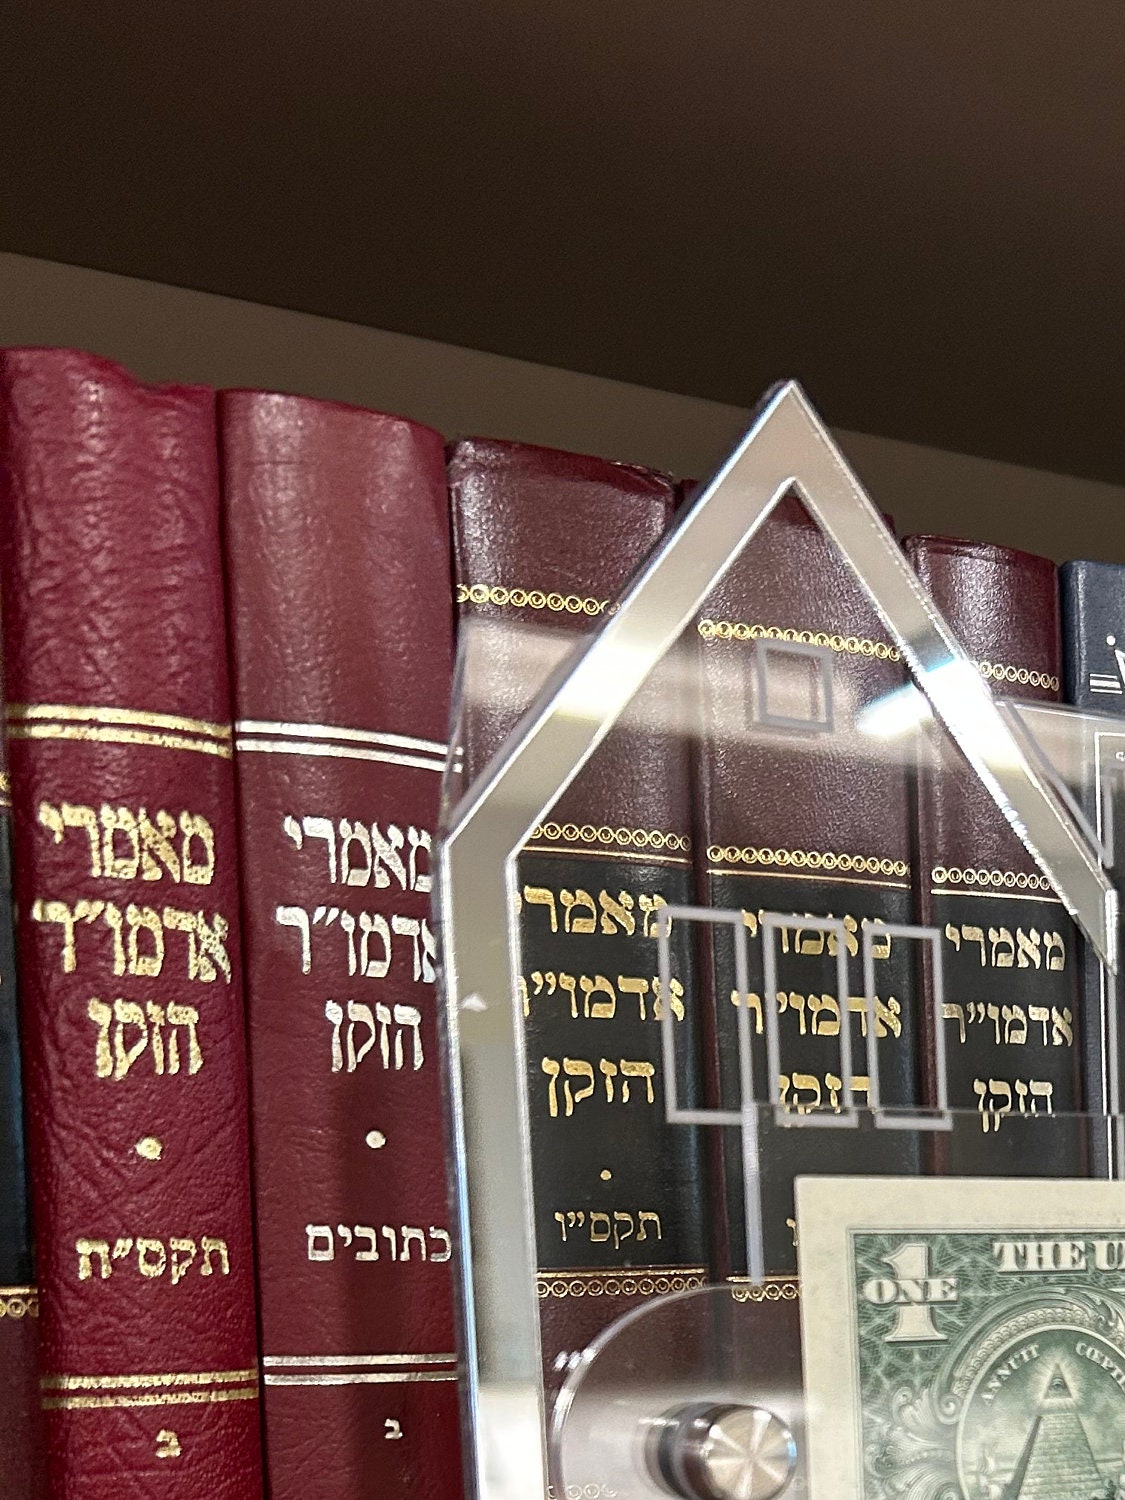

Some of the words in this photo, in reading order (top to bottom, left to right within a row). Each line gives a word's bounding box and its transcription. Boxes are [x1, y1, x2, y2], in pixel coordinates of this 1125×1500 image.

[38, 801, 215, 885] מאמרי
[944, 922, 1066, 972] מאמרי
[326, 1000, 425, 1073] הזקן
[541, 1056, 656, 1118] הזקן
[973, 1077, 1055, 1133] הזקן
[305, 1223, 453, 1263] כתובים
[993, 1240, 1088, 1272] THE
[863, 1277, 959, 1306] ONE
